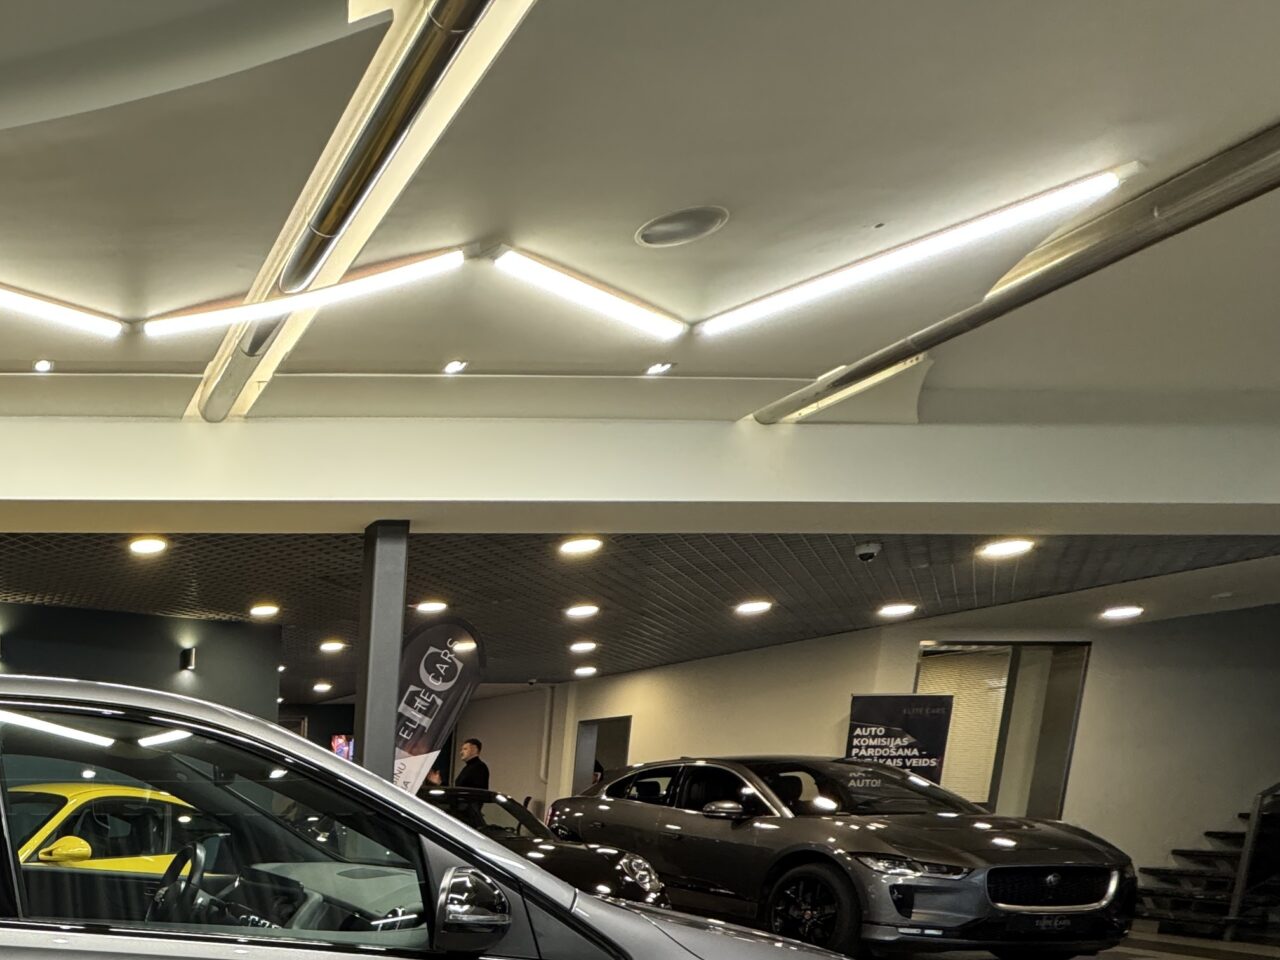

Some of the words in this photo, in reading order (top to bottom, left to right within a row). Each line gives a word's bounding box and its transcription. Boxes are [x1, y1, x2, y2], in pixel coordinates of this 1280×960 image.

[400, 688, 434, 740] ELITE
[429, 638, 460, 687] CARS
[853, 727, 885, 736] AUTO
[852, 737, 909, 747] KOMISIJAS
[851, 746, 919, 756] PĀRDOŠANA
[906, 758, 937, 767] VEIDS
[848, 779, 881, 788] AUTO!
